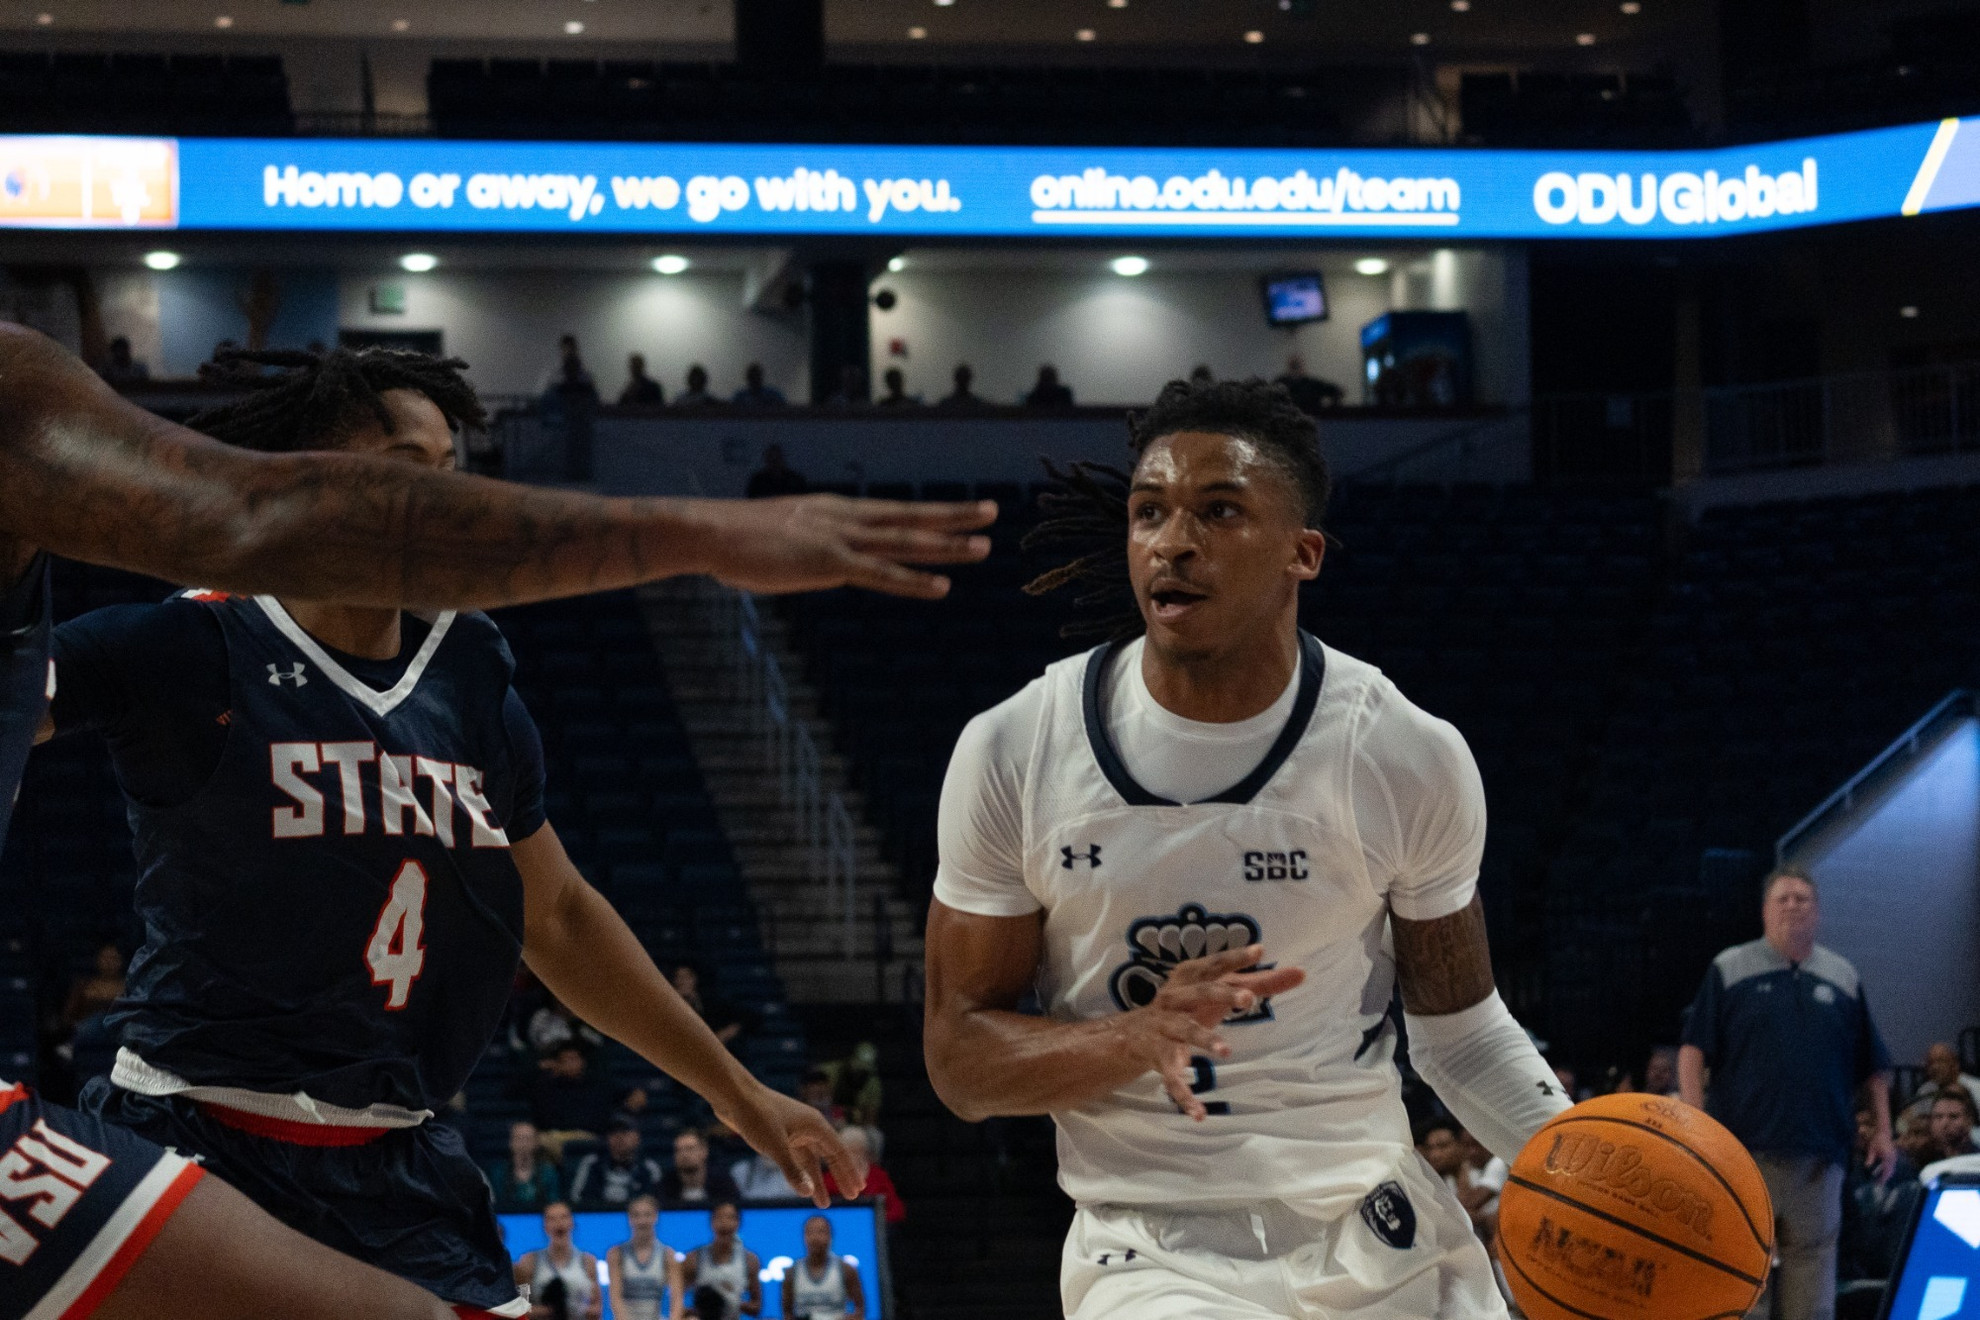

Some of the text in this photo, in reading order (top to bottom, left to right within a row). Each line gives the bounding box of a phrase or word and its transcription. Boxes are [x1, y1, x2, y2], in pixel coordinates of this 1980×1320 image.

[263, 165, 961, 223] Home or away, we go with you.
[1030, 167, 1461, 213] online.odu.edu/team
[269, 740, 511, 849] STATE
[1243, 850, 1309, 882] SBC
[362, 857, 429, 1011] 4
